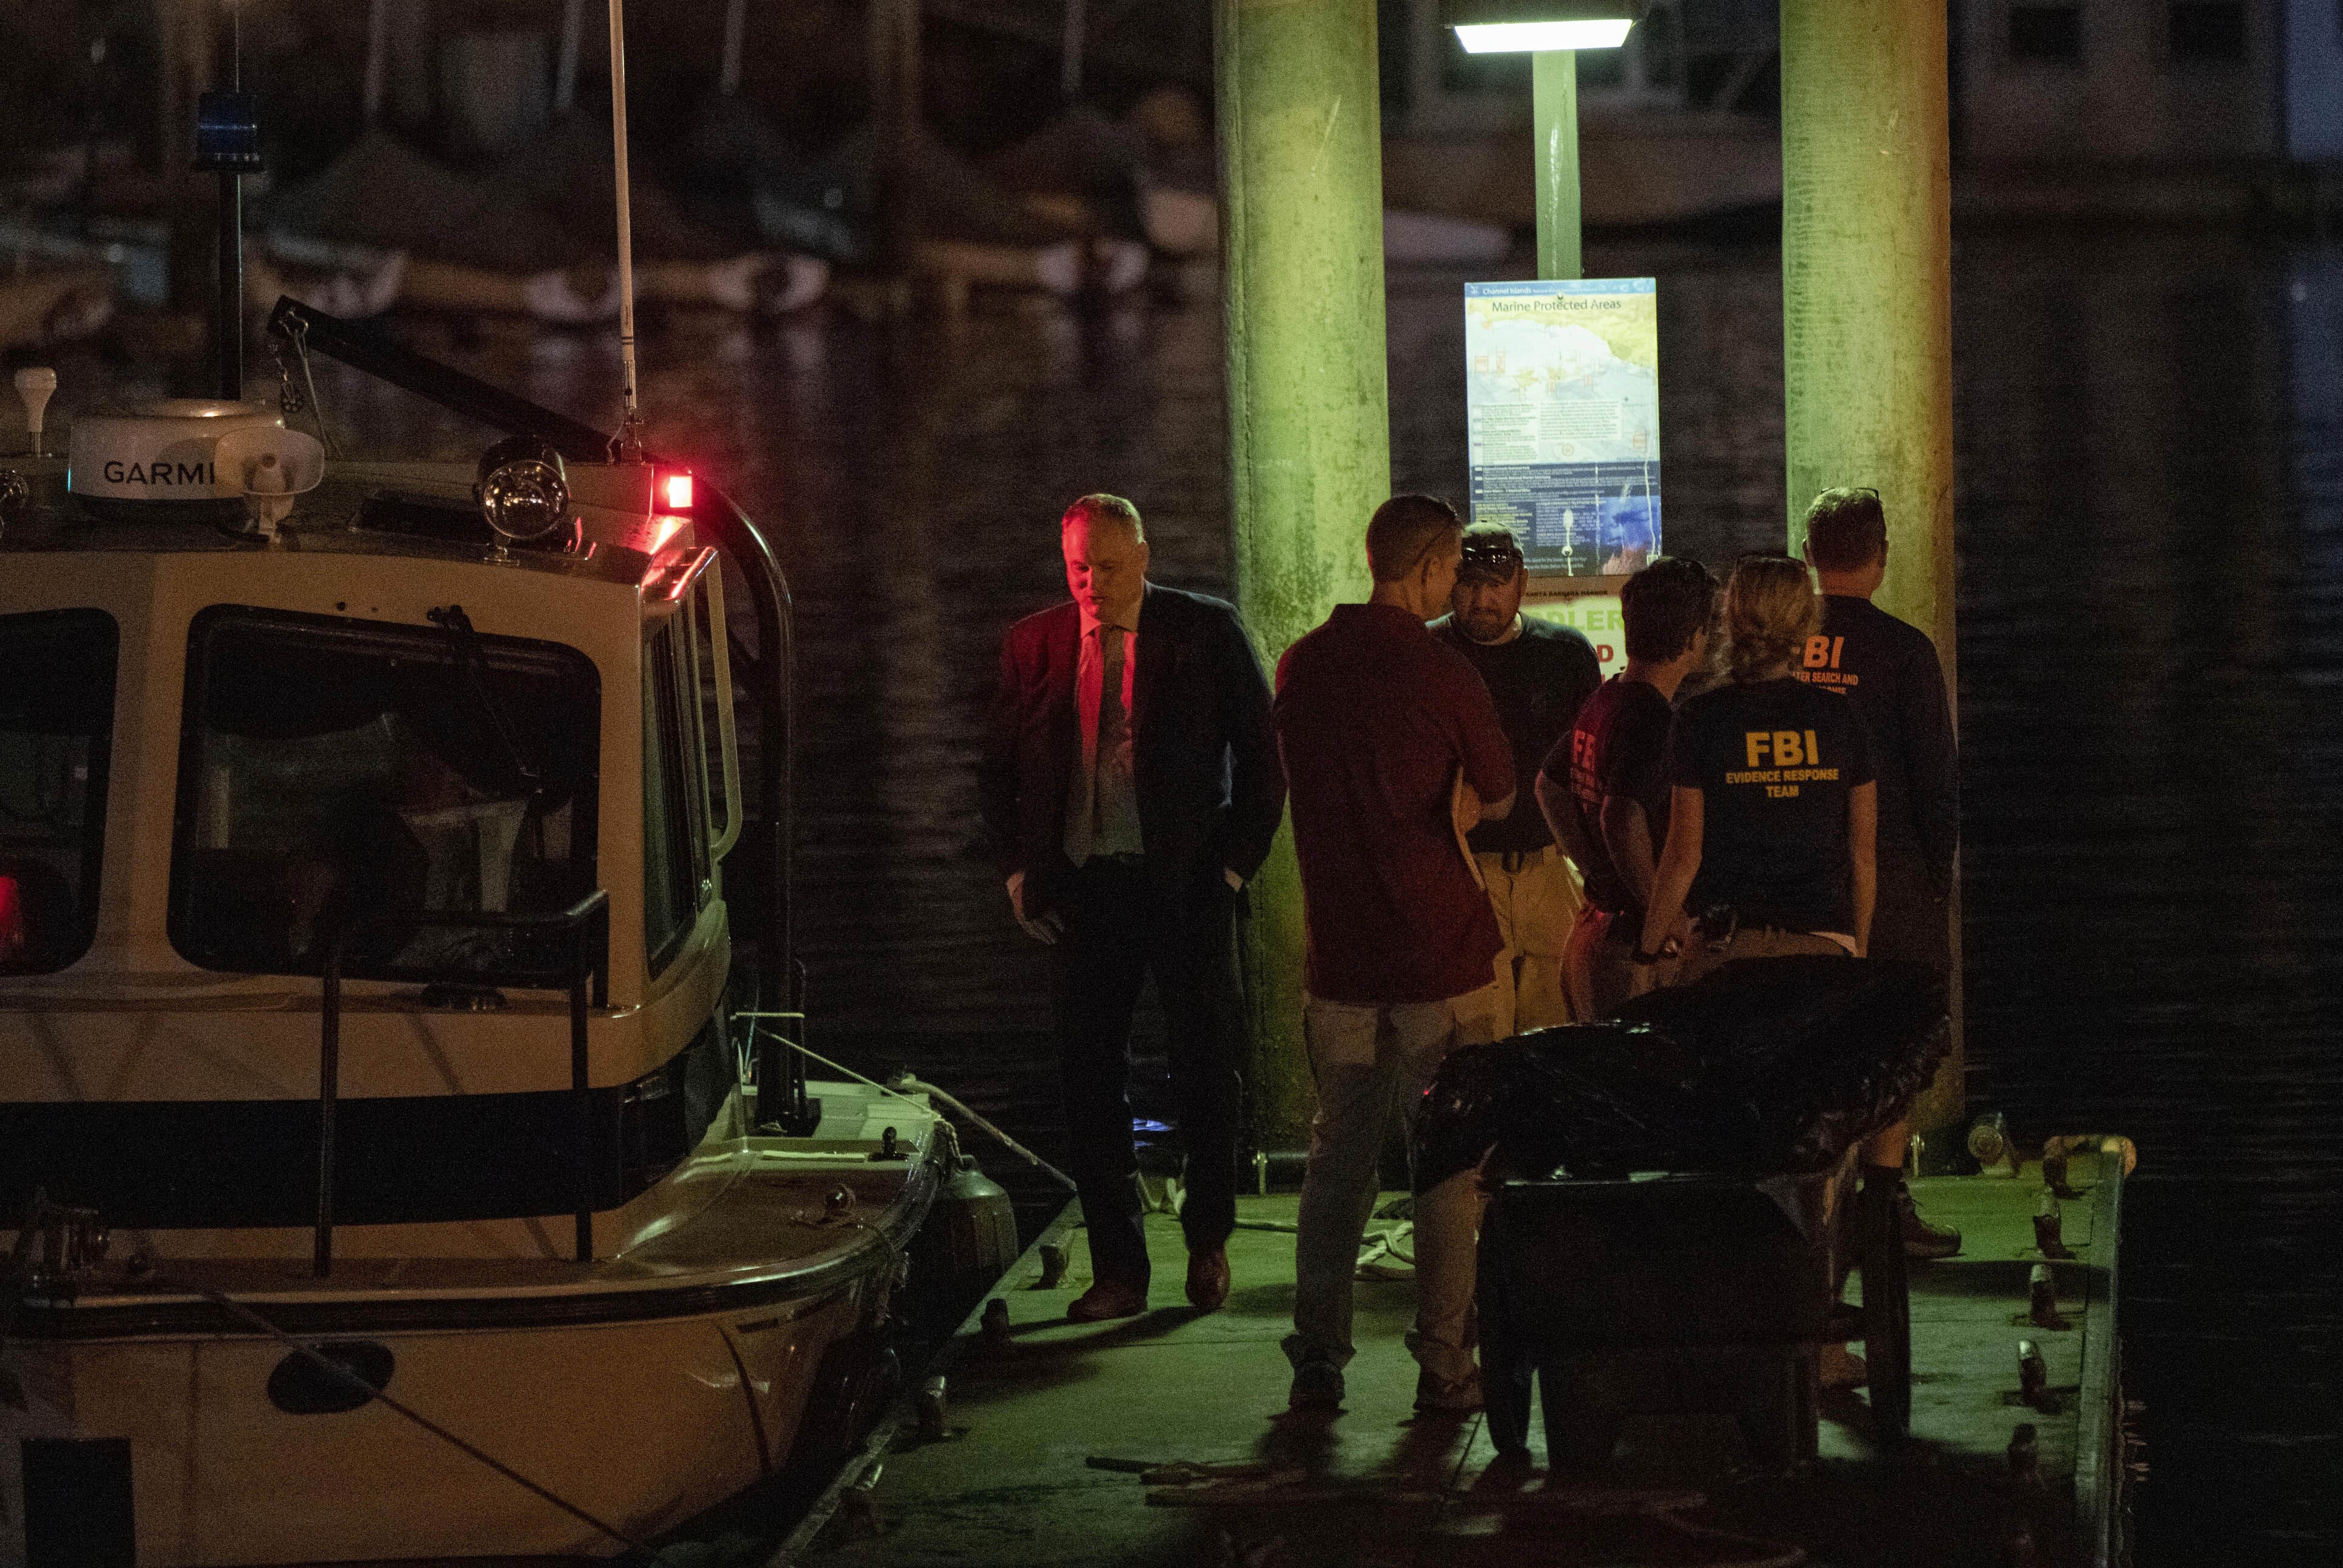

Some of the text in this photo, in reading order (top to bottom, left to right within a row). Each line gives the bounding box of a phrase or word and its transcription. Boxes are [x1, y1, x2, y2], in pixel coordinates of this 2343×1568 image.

[1492, 299, 1621, 311] Marine Protected Areas
[104, 461, 214, 485] GARMI
[1803, 635, 1845, 668] BI
[1812, 671, 1841, 684] SEARCH
[1842, 674, 1859, 686] AND
[1746, 729, 1819, 768] FBI
[1726, 768, 1839, 784] EVIDENCE RESPONSE
[1766, 784, 1799, 797] TEAM
